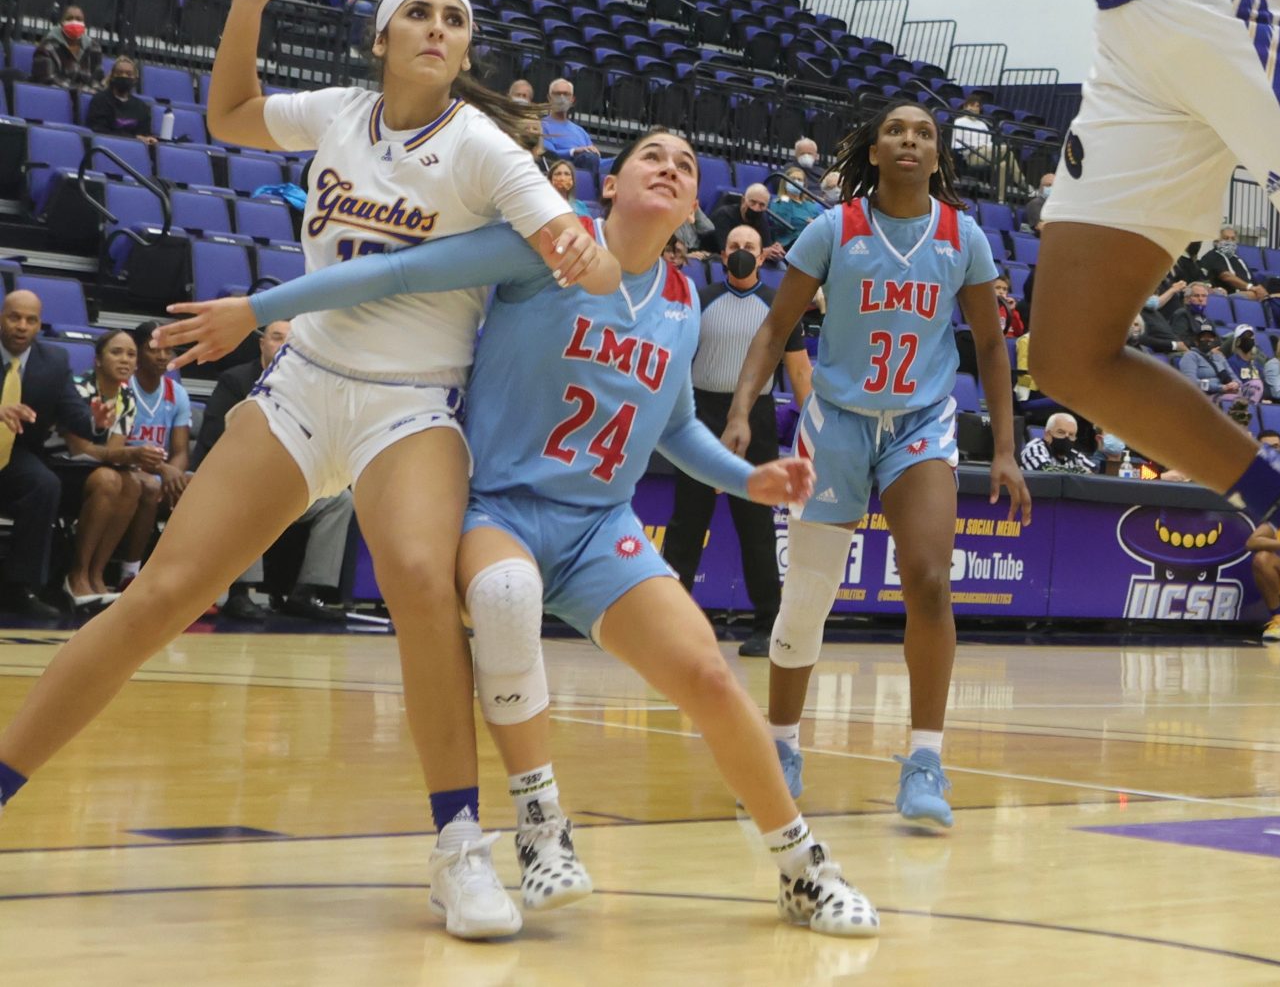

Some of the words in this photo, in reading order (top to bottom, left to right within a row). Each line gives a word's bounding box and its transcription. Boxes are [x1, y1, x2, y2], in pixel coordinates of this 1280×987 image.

[307, 167, 440, 239] Gauchos
[859, 278, 940, 322] LMU
[561, 314, 672, 394] LMU
[862, 329, 919, 395] 32
[127, 424, 167, 446] LMU
[541, 383, 639, 484] 24
[966, 519, 994, 536] SOCIAL
[996, 520, 1021, 537] MEDIA
[1127, 582, 1239, 621] UCSB
